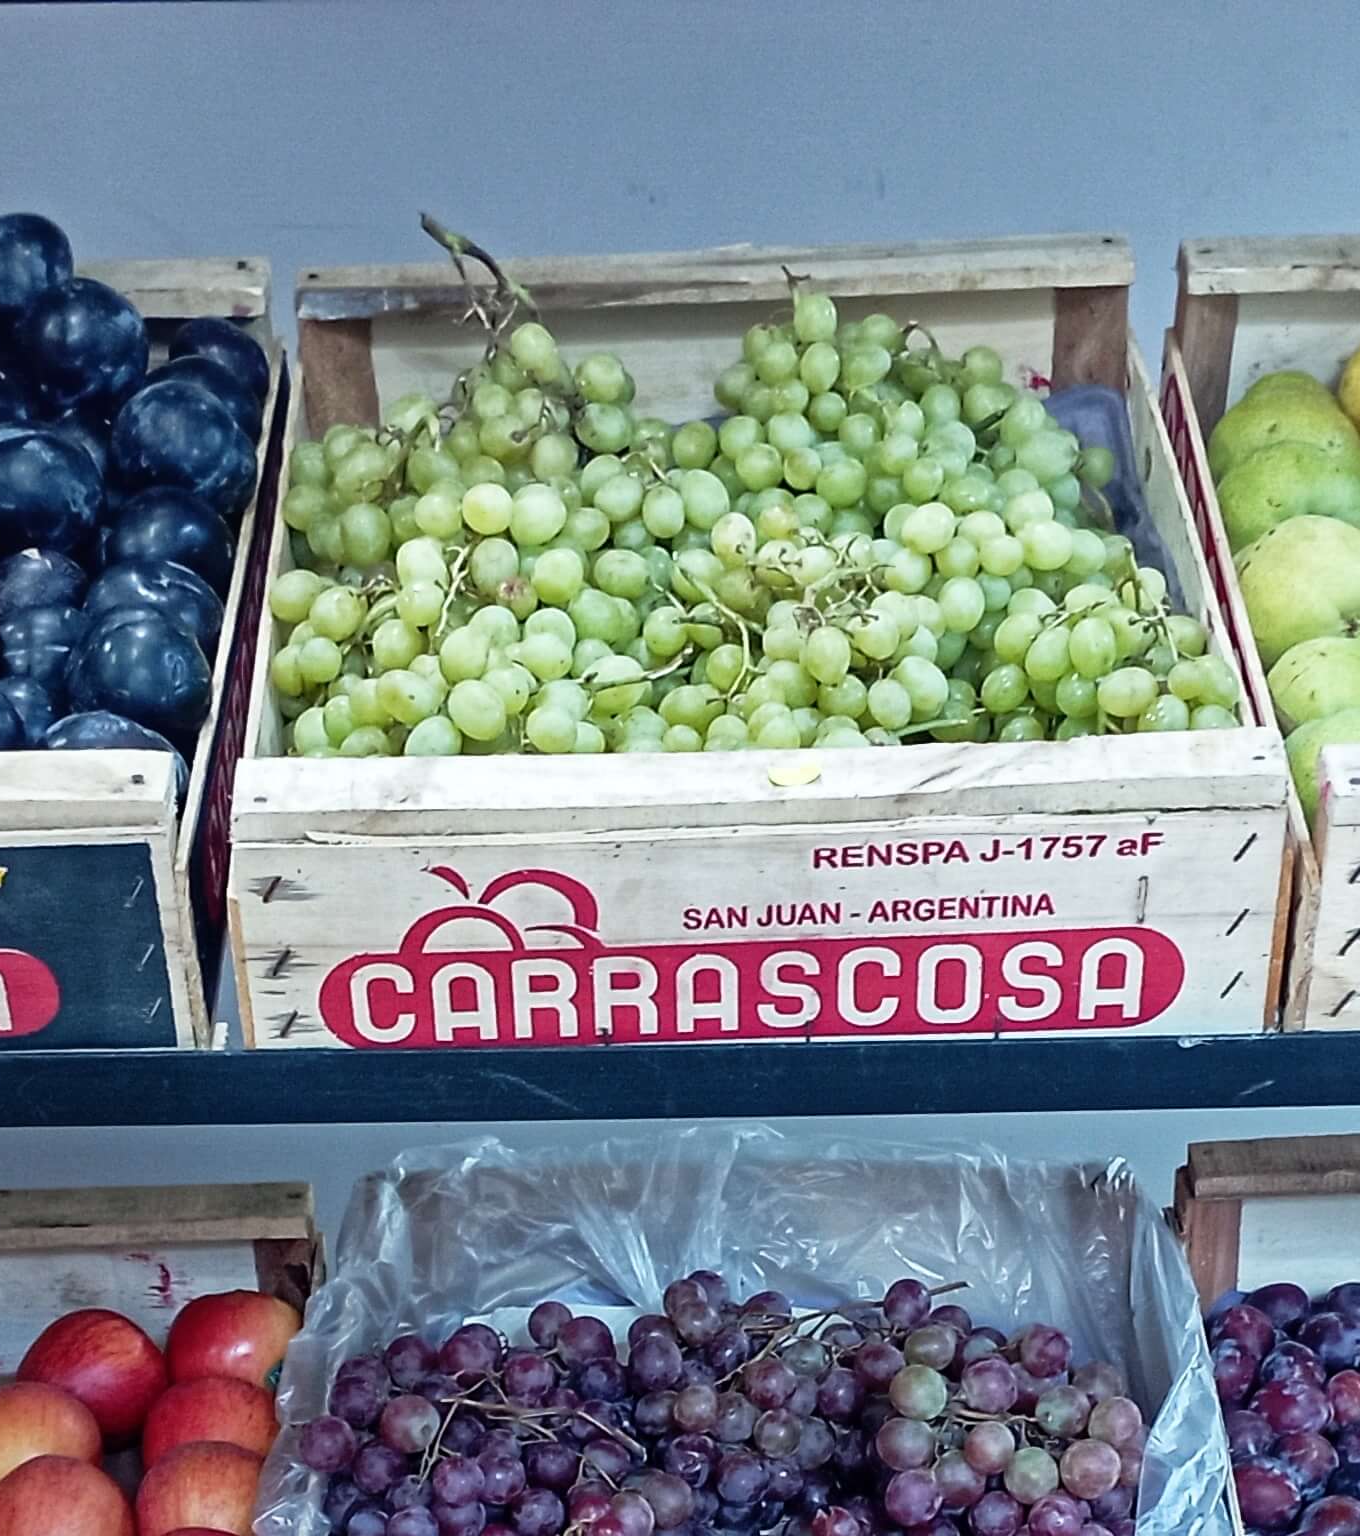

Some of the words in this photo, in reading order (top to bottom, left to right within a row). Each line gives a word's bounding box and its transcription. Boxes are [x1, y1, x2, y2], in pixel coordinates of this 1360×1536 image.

[812, 840, 970, 870] RENSPA
[978, 834, 1108, 861] J-1757
[682, 904, 749, 930] SAN
[757, 901, 842, 928] JUAN
[868, 893, 1056, 922] ARGENTINA
[351, 937, 1144, 1041] CARRASCOSA
